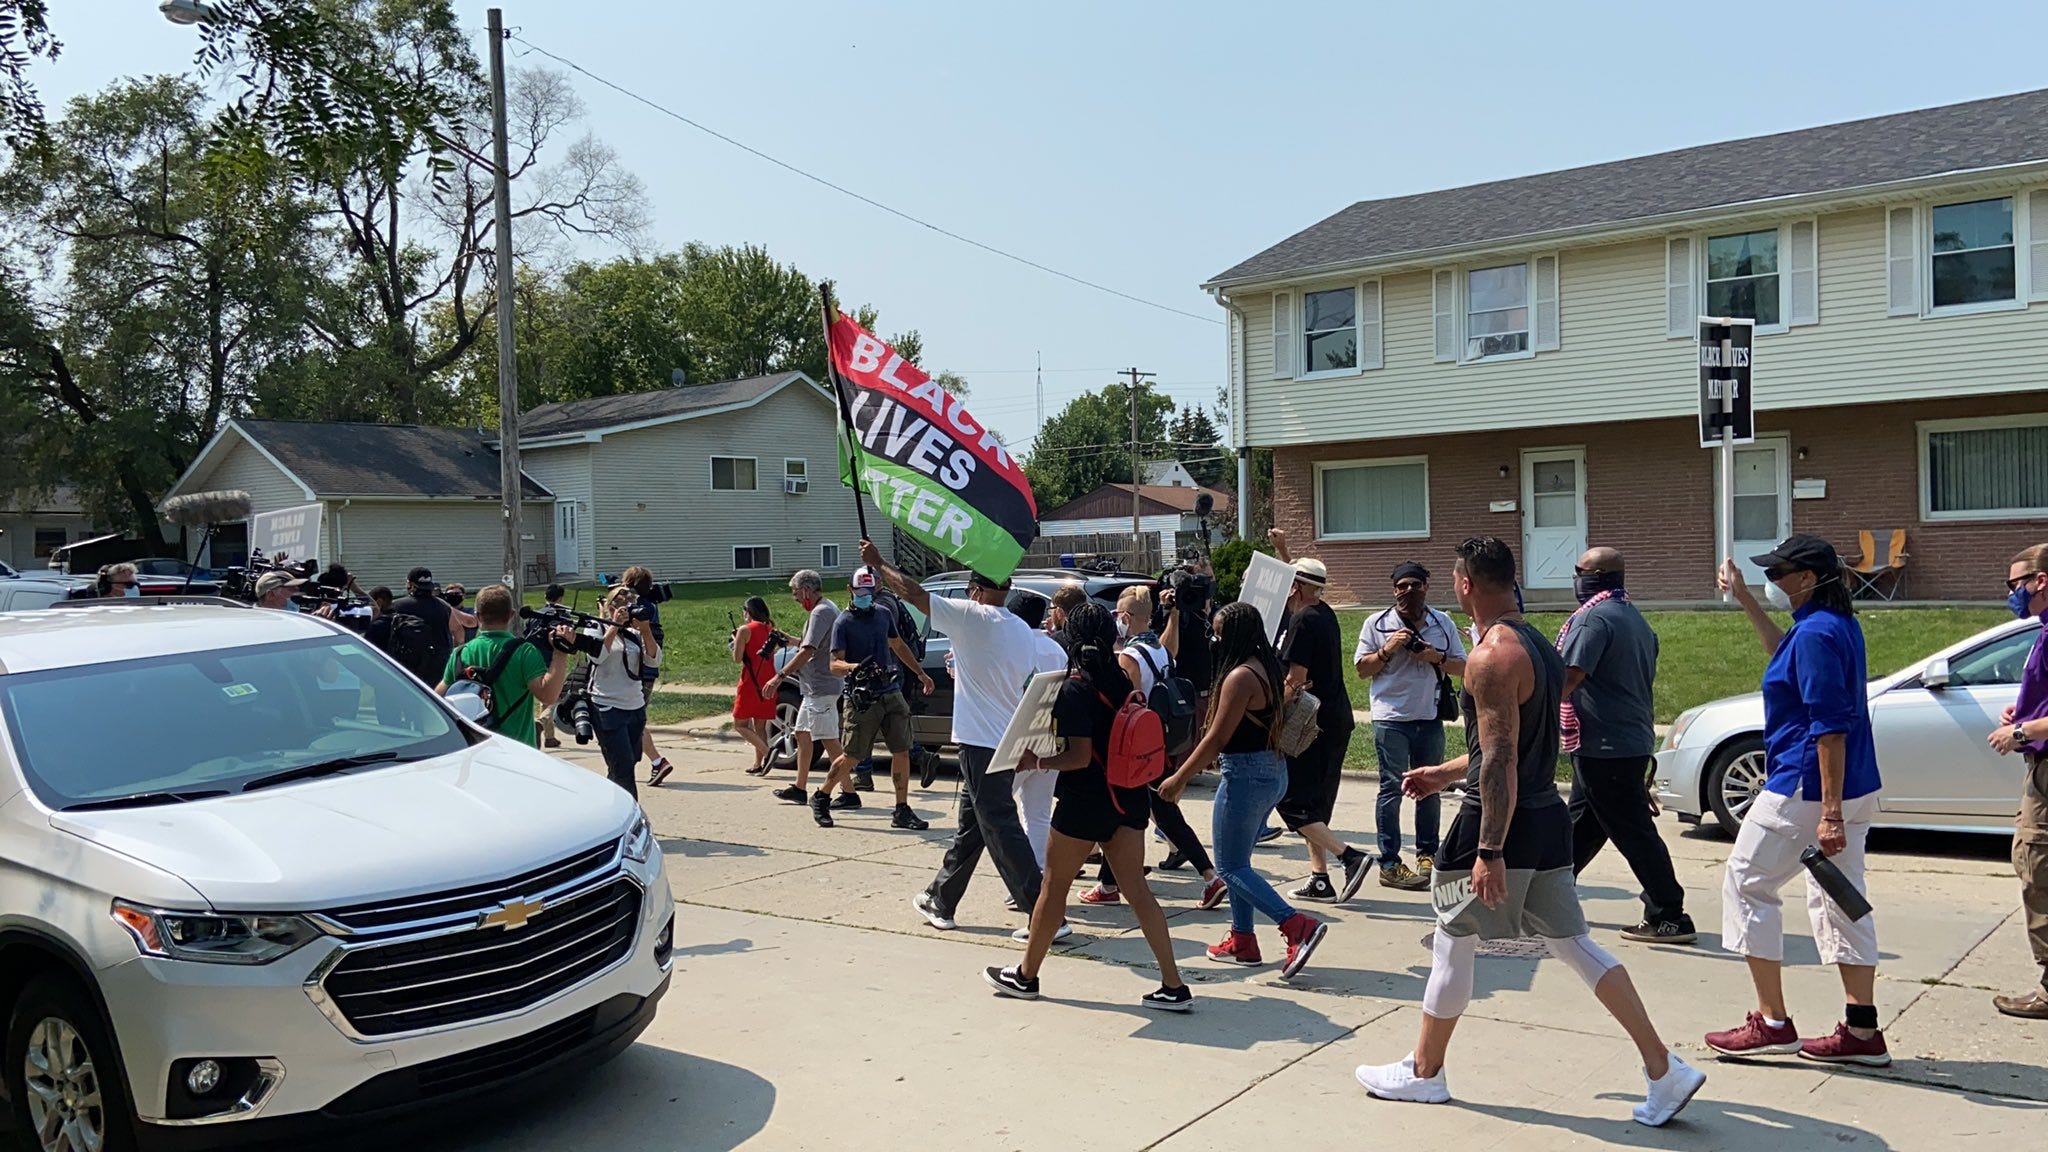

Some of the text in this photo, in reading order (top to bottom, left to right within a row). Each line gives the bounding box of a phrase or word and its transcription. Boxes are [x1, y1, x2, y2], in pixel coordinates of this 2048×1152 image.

[850, 391, 976, 491] LIVES
[860, 466, 973, 547] TTER
[1435, 875, 1472, 908] NIKE
